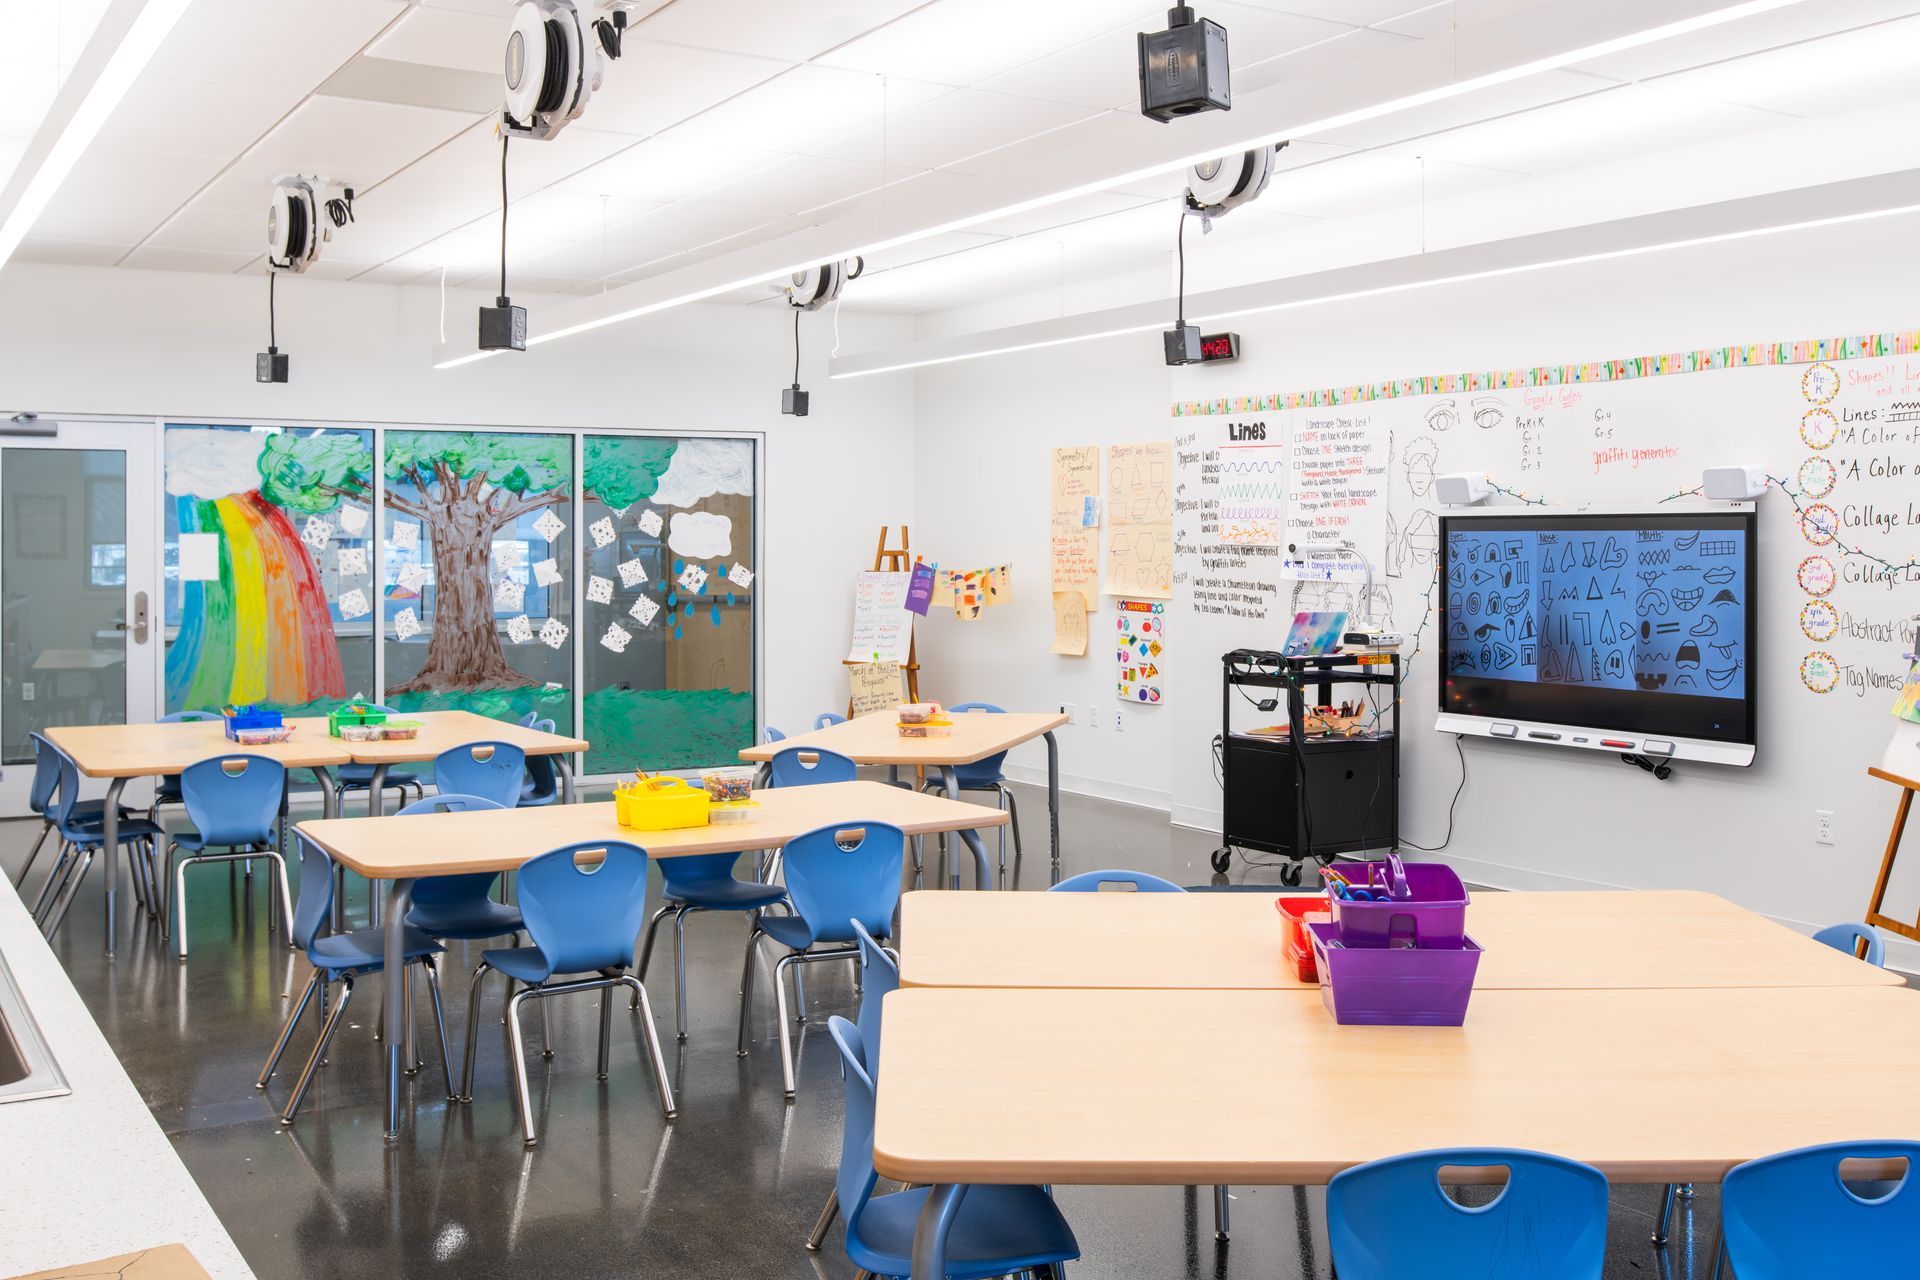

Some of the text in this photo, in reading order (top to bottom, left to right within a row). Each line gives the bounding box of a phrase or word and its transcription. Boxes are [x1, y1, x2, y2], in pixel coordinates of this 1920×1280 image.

[1229, 422, 1267, 441] Lines
[1302, 431, 1319, 442] NAME
[1349, 431, 1366, 441] paper
[1815, 420, 1823, 435] K
[1862, 427, 1897, 445] Color
[1593, 446, 1681, 474] graffiti generator
[1869, 455, 1906, 478] Color
[1843, 505, 1899, 534] Collage
[1539, 532, 1559, 544] Nose:
[1637, 530, 1664, 543] Mouth:
[1843, 562, 1900, 591] Collage
[1127, 602, 1148, 611] SHAPES
[1808, 620, 1829, 629] grade
[1841, 611, 1894, 643] Abstract
[1810, 660, 1823, 669] 5th
[1840, 665, 1905, 697] Tag Names
